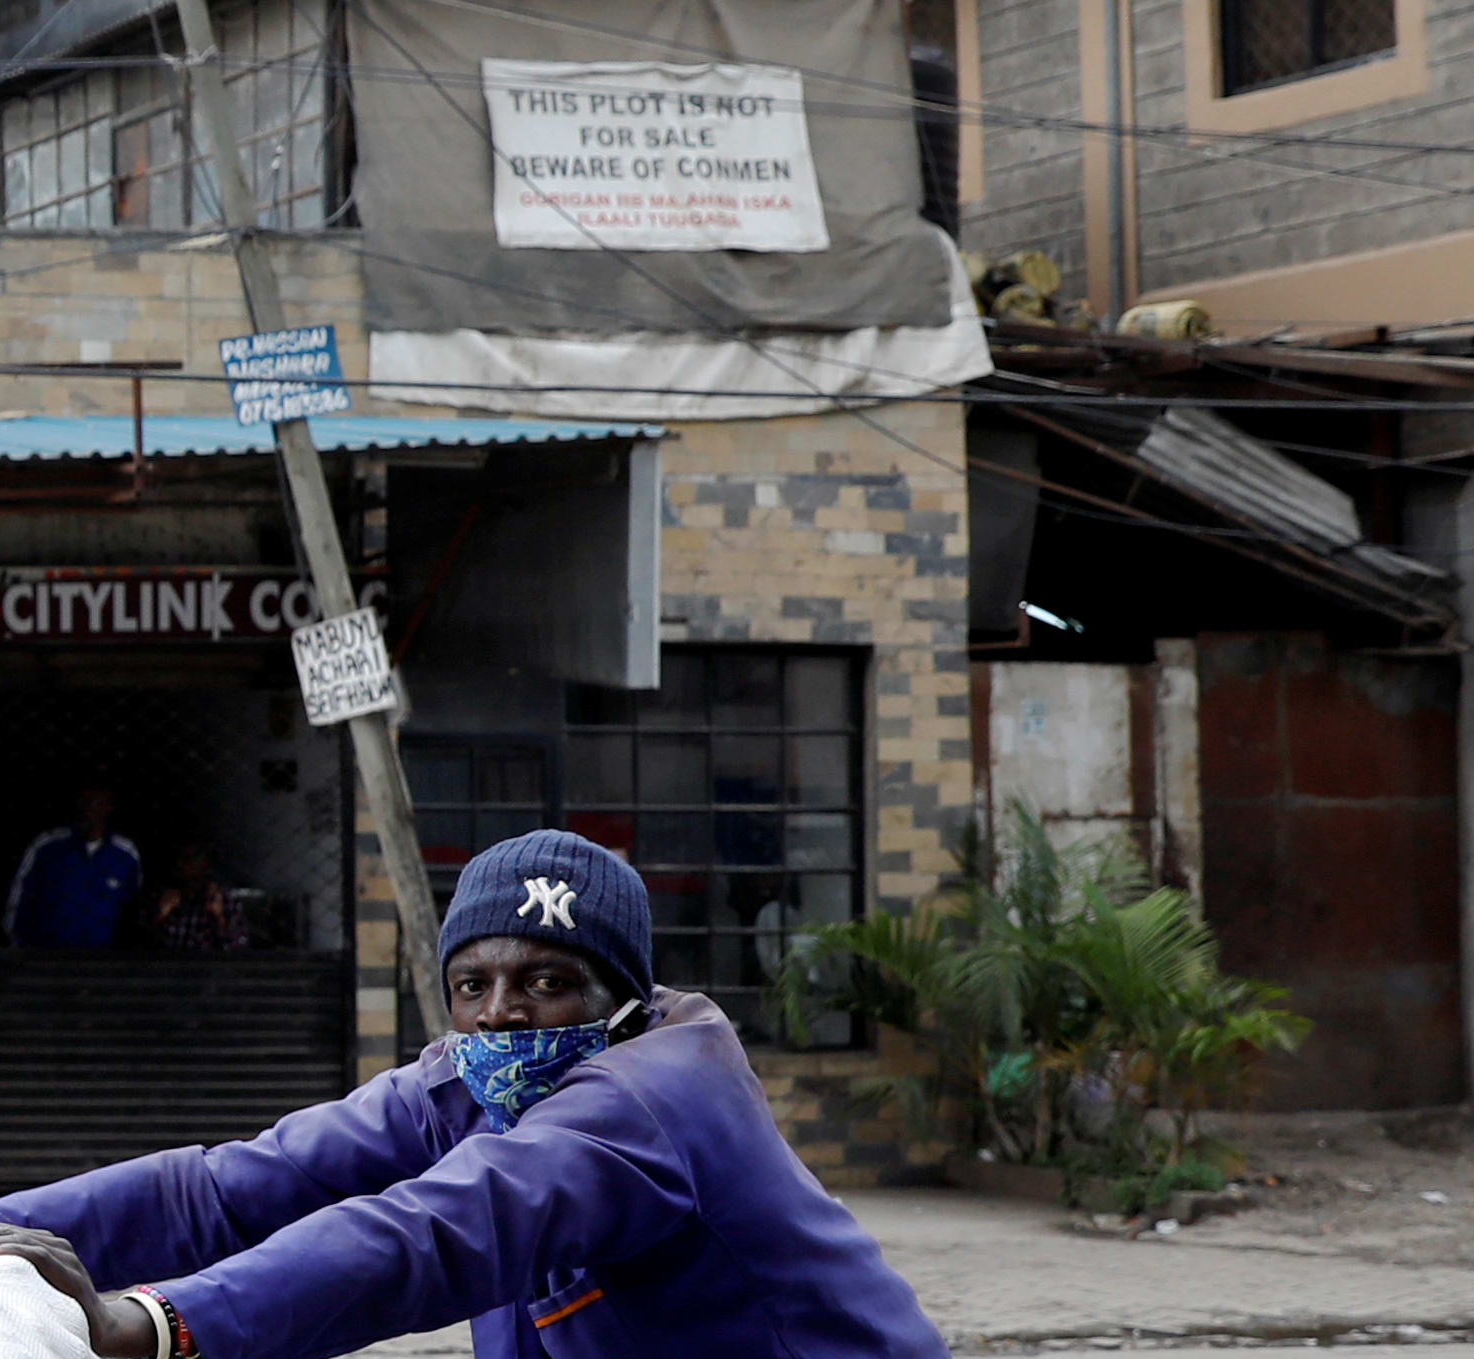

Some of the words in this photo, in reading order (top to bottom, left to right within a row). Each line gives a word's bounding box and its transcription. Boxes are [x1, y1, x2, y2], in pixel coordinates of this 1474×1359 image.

[508, 89, 577, 115] THIS
[590, 93, 666, 116] PLOT
[680, 93, 707, 116] IS
[716, 96, 776, 118] NOT
[580, 126, 633, 148] FOR
[645, 127, 717, 148] SALE
[511, 155, 622, 179] BEWARE
[634, 157, 666, 180] OF
[678, 158, 791, 182] CONMEN
[3, 579, 234, 634] CITYLINK
